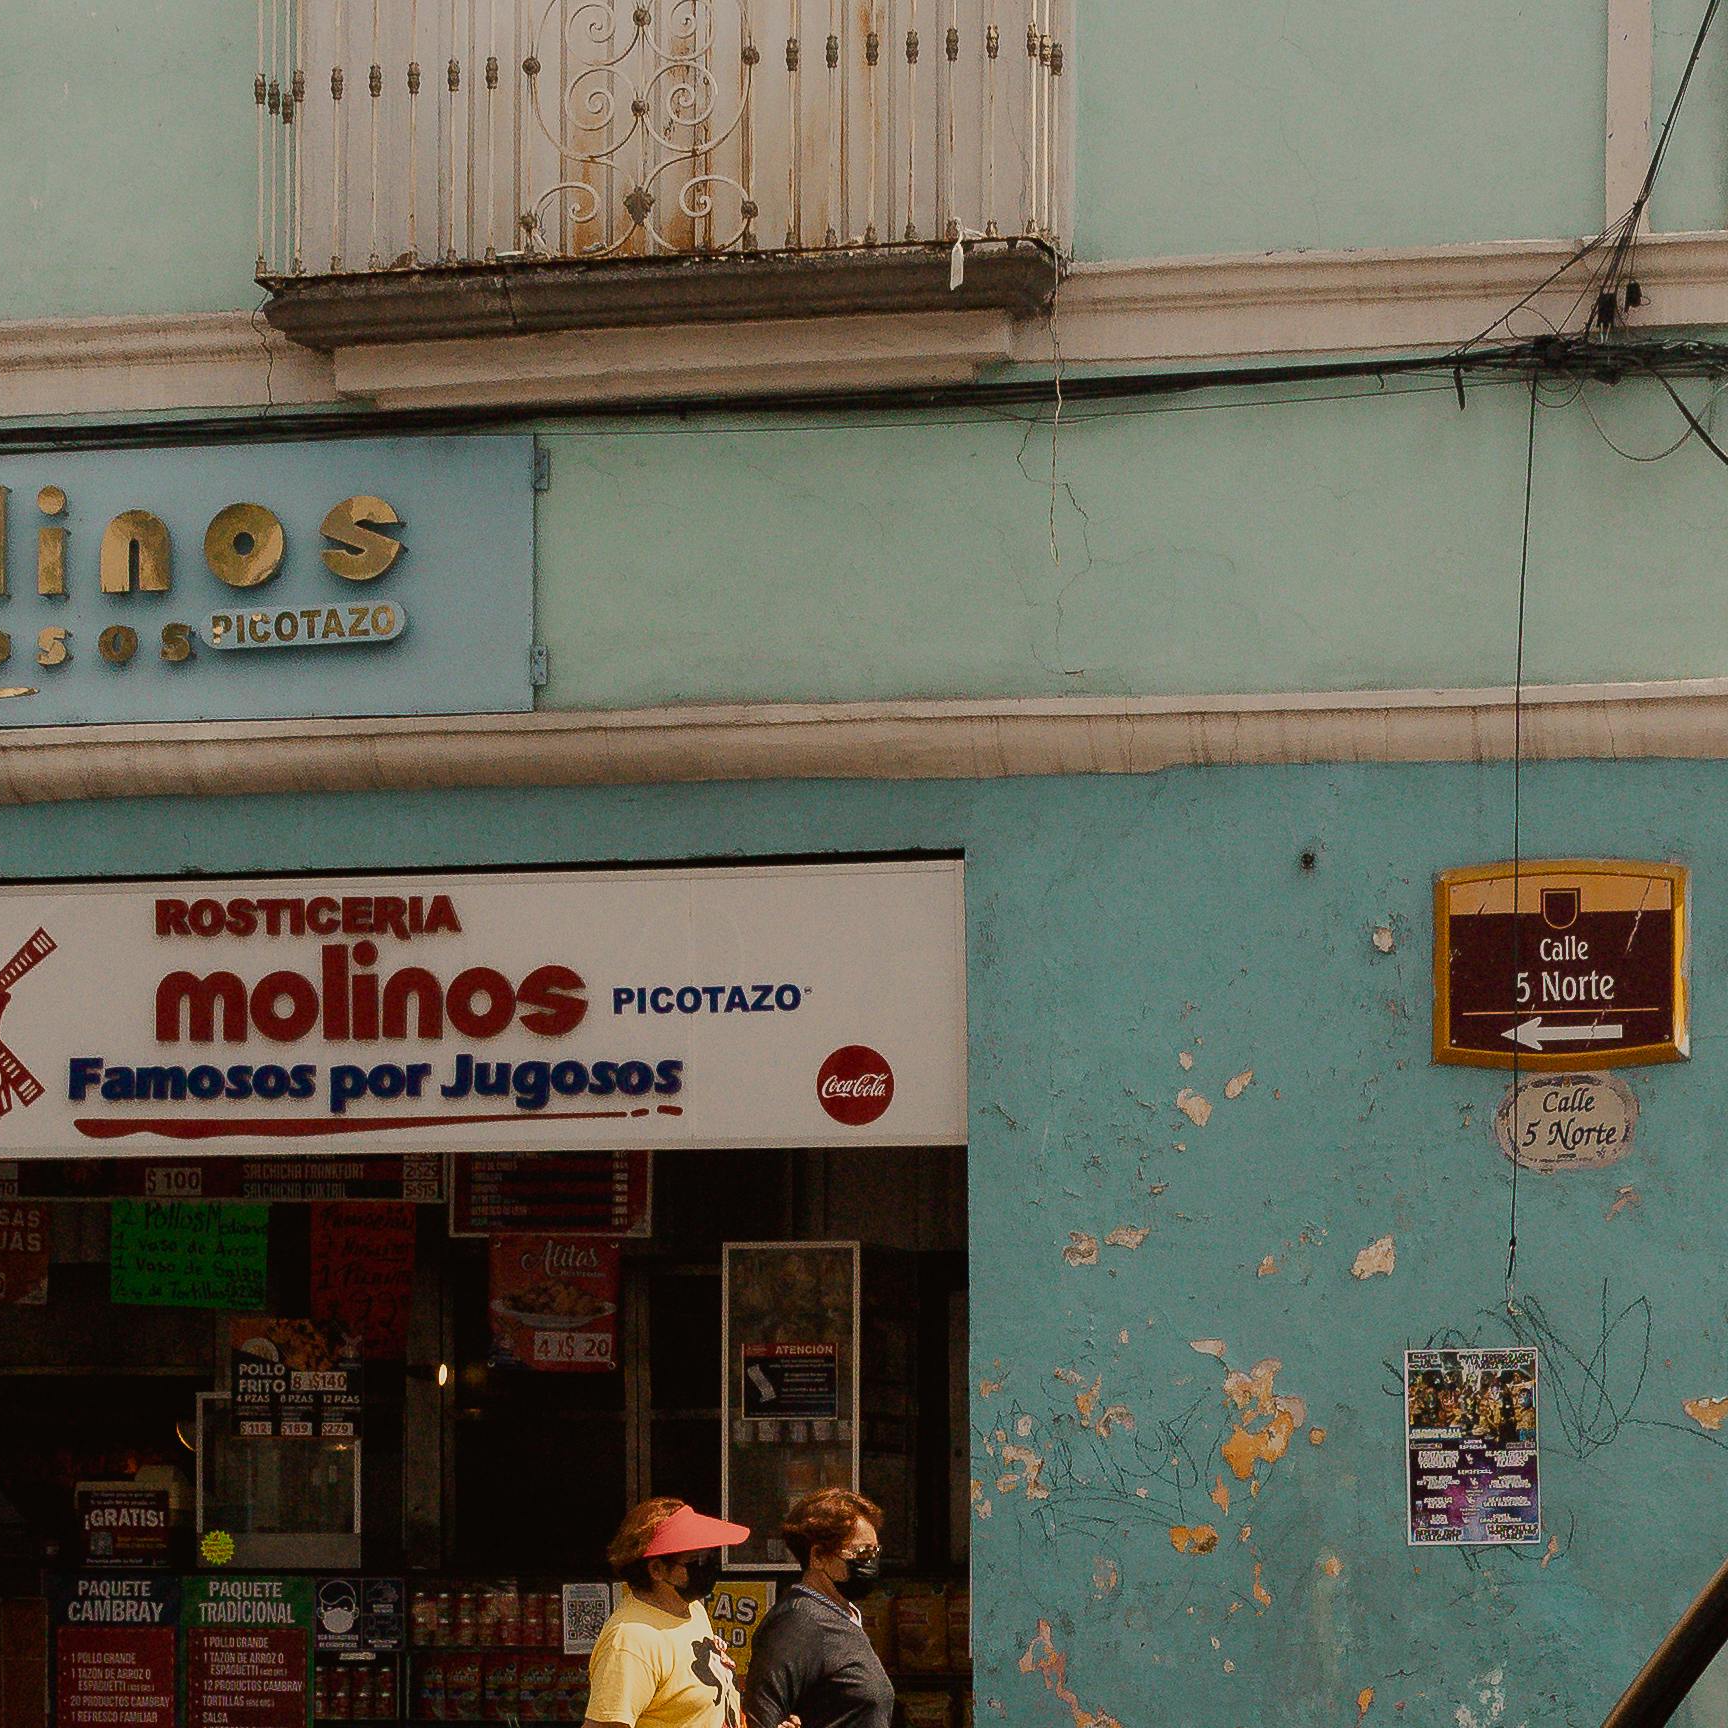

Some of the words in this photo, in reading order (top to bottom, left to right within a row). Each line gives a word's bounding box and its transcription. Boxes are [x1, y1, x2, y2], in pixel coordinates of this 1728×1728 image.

[211, 604, 396, 645] PICOTAZO
[155, 895, 462, 940] ROSTICERIA
[1539, 935, 1590, 962] Calle
[155, 940, 588, 1043] molinos
[1516, 971, 1531, 1003] 5
[1541, 970, 1615, 1002] Norte
[68, 1057, 317, 1100] Famosos
[330, 1059, 432, 1114] por
[441, 1053, 684, 1115] Jugosos
[1542, 1087, 1595, 1113] Calle
[1523, 1120, 1541, 1146] 5
[1547, 1118, 1617, 1150] Norte
[242, 1162, 302, 1179] SALCHICHA
[304, 1162, 364, 1179] FRANKFURT
[164, 1171, 200, 1191] 100
[242, 1182, 302, 1198] SALCHICHA
[521, 1239, 599, 1277] Alitas
[537, 1339, 550, 1356] 4
[585, 1339, 609, 1356] 20
[239, 1363, 286, 1376] POLLO
[239, 1379, 287, 1393] FRITO
[288, 1395, 314, 1404] PZAS
[334, 1394, 360, 1404] PZAS
[84, 1507, 165, 1531] ¡GRATIS!
[77, 1580, 152, 1598] PAQUETE
[209, 1581, 283, 1599] PAQUETE
[67, 1600, 164, 1623] CAMBRAY
[198, 1602, 295, 1623] TRADICIONAL
[209, 1636, 234, 1648] POLLO
[236, 1636, 269, 1648] GRANDE
[77, 1652, 102, 1664] POLLO
[103, 1652, 137, 1664] GRANDE
[238, 1652, 248, 1664] DE
[249, 1652, 276, 1664] ARROZ
[105, 1668, 115, 1680] DE
[117, 1668, 143, 1680] ARROZ
[214, 1680, 262, 1692] PRODUCTOS
[263, 1680, 303, 1692] CAMBRAY
[82, 1696, 129, 1708] PRODUCTOS
[131, 1696, 170, 1708] CAMBRAY
[202, 1695, 244, 1707] TORTILLAS
[77, 1711, 118, 1723] REFRESCO
[119, 1711, 158, 1723] FAMILIAR
[202, 1711, 228, 1723] SALSA
